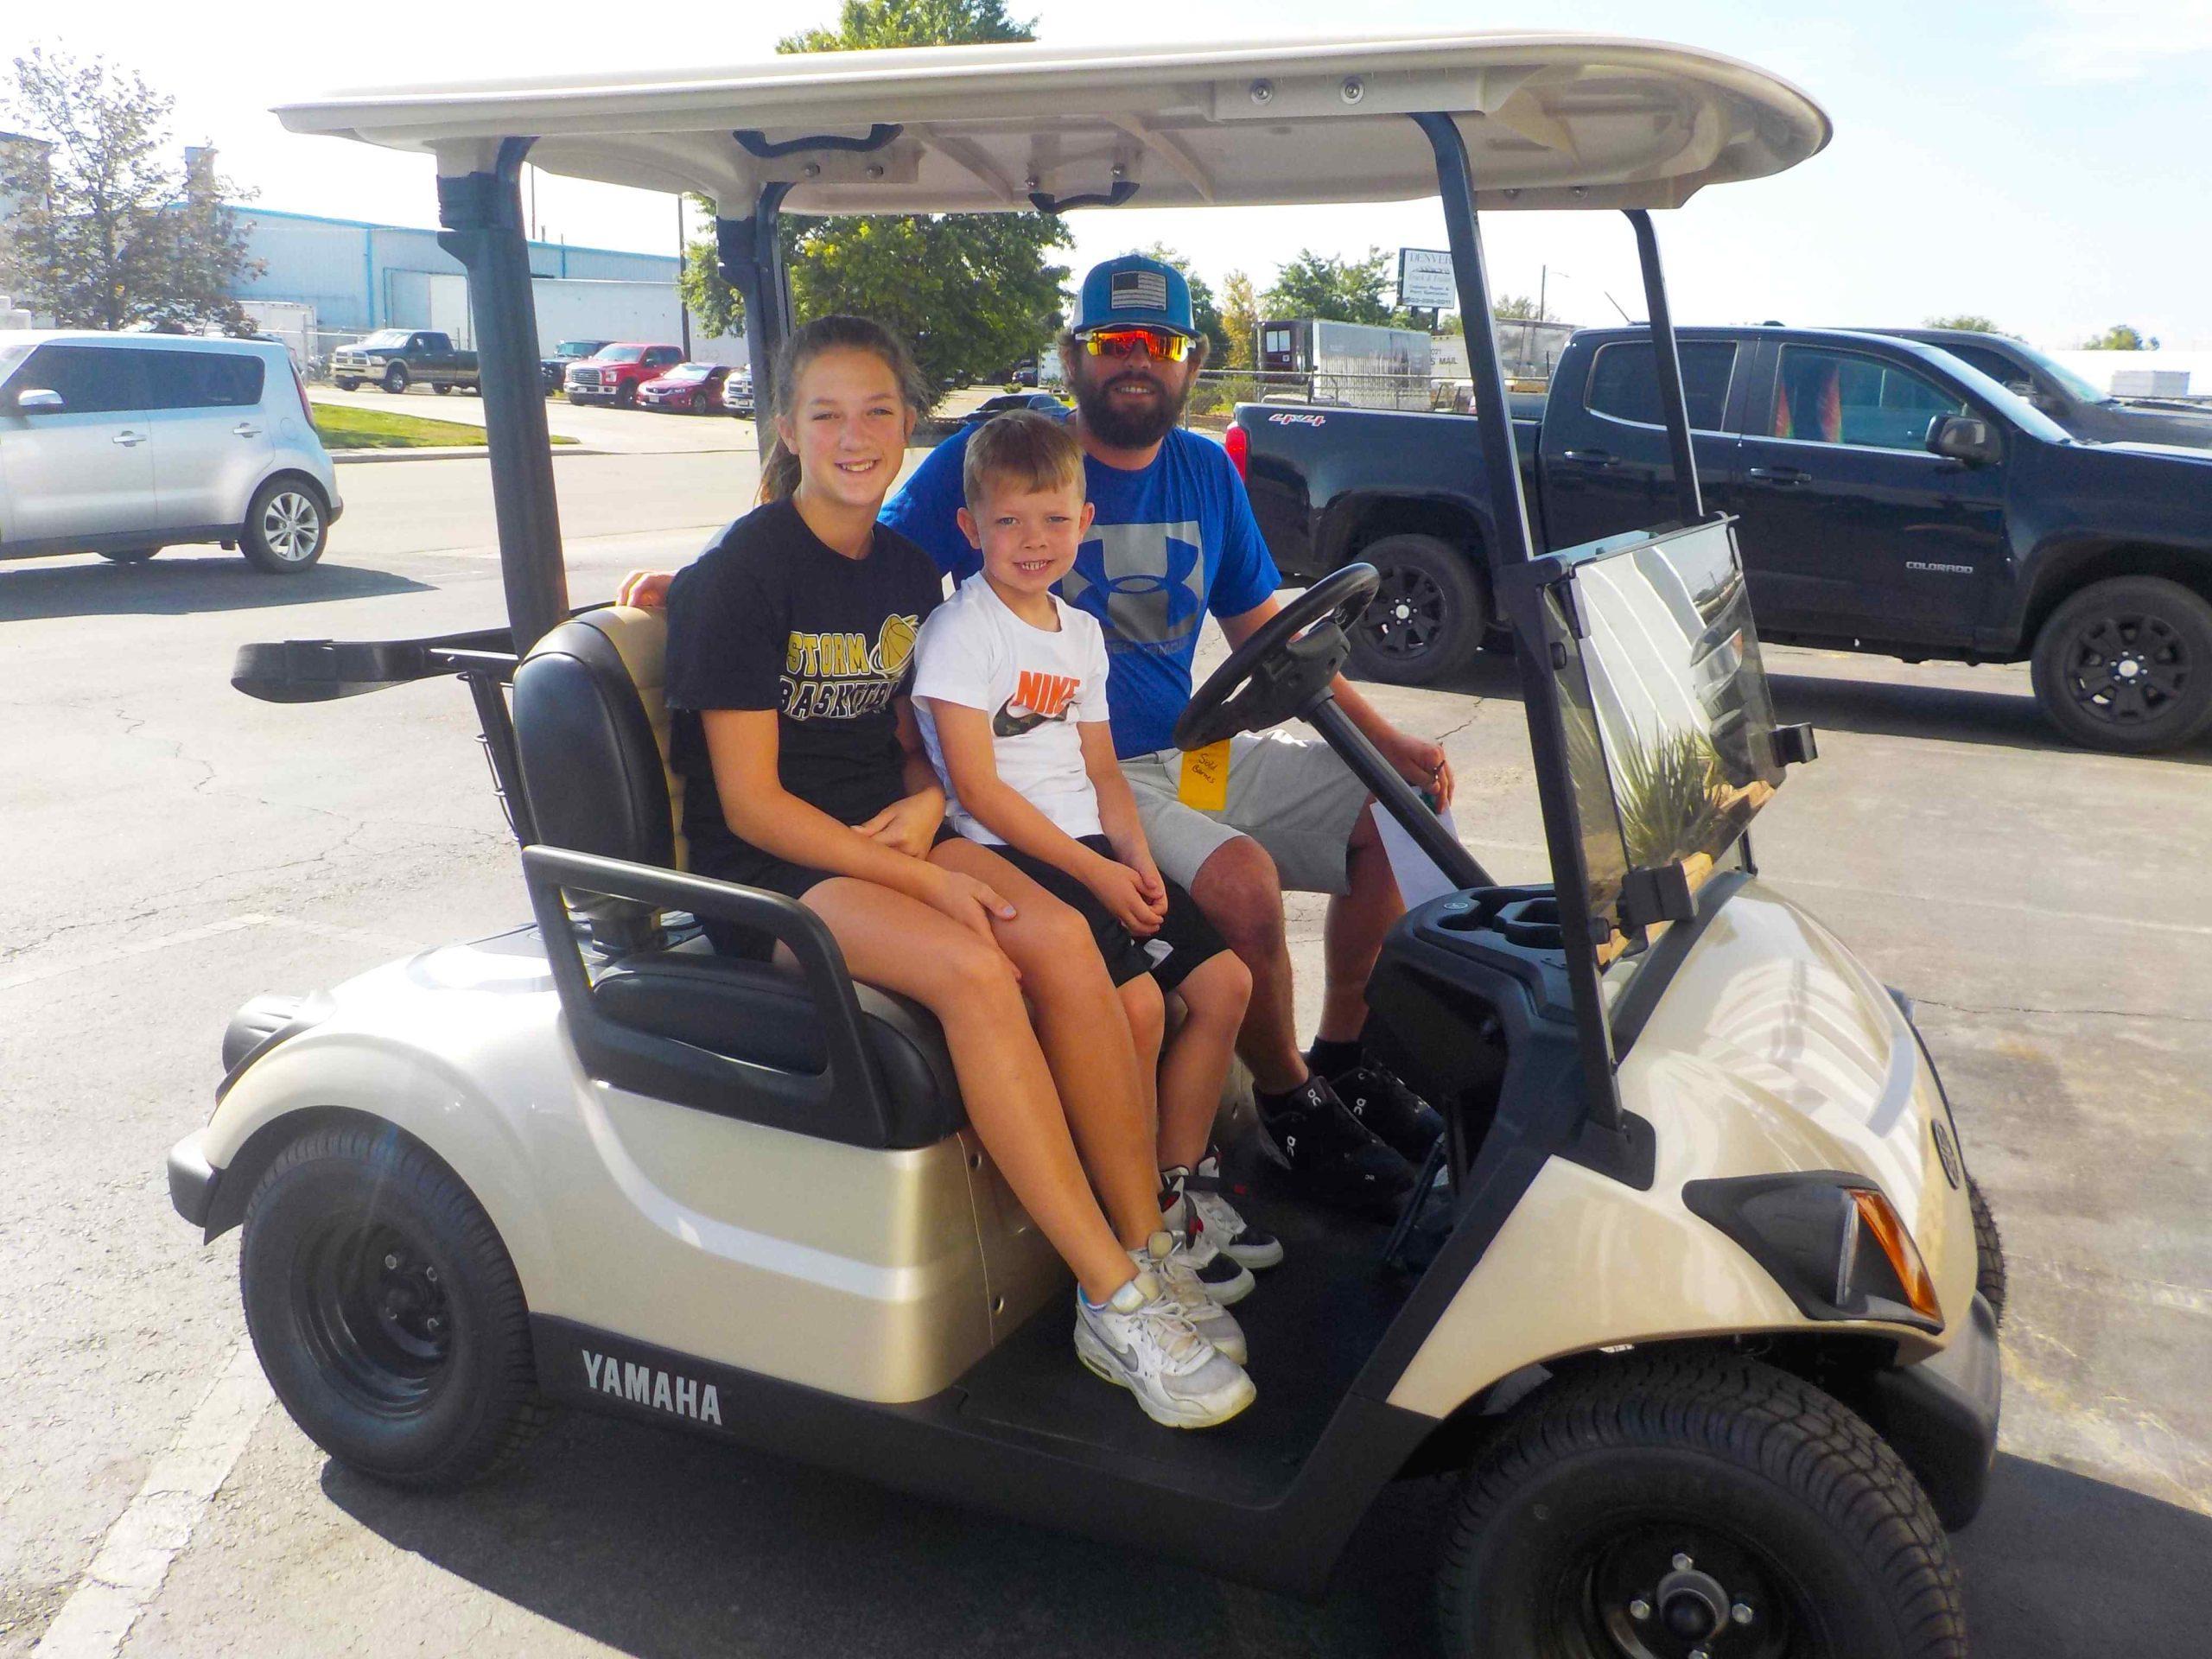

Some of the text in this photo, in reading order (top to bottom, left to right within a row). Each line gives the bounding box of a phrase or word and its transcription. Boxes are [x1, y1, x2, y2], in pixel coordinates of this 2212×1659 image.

[1905, 561, 1974, 574] COLORADO
[786, 631, 871, 677] STORM
[1010, 670, 1081, 715] NIKE
[1198, 753, 1218, 771] Sold
[582, 1349, 722, 1426] YAMAHA
